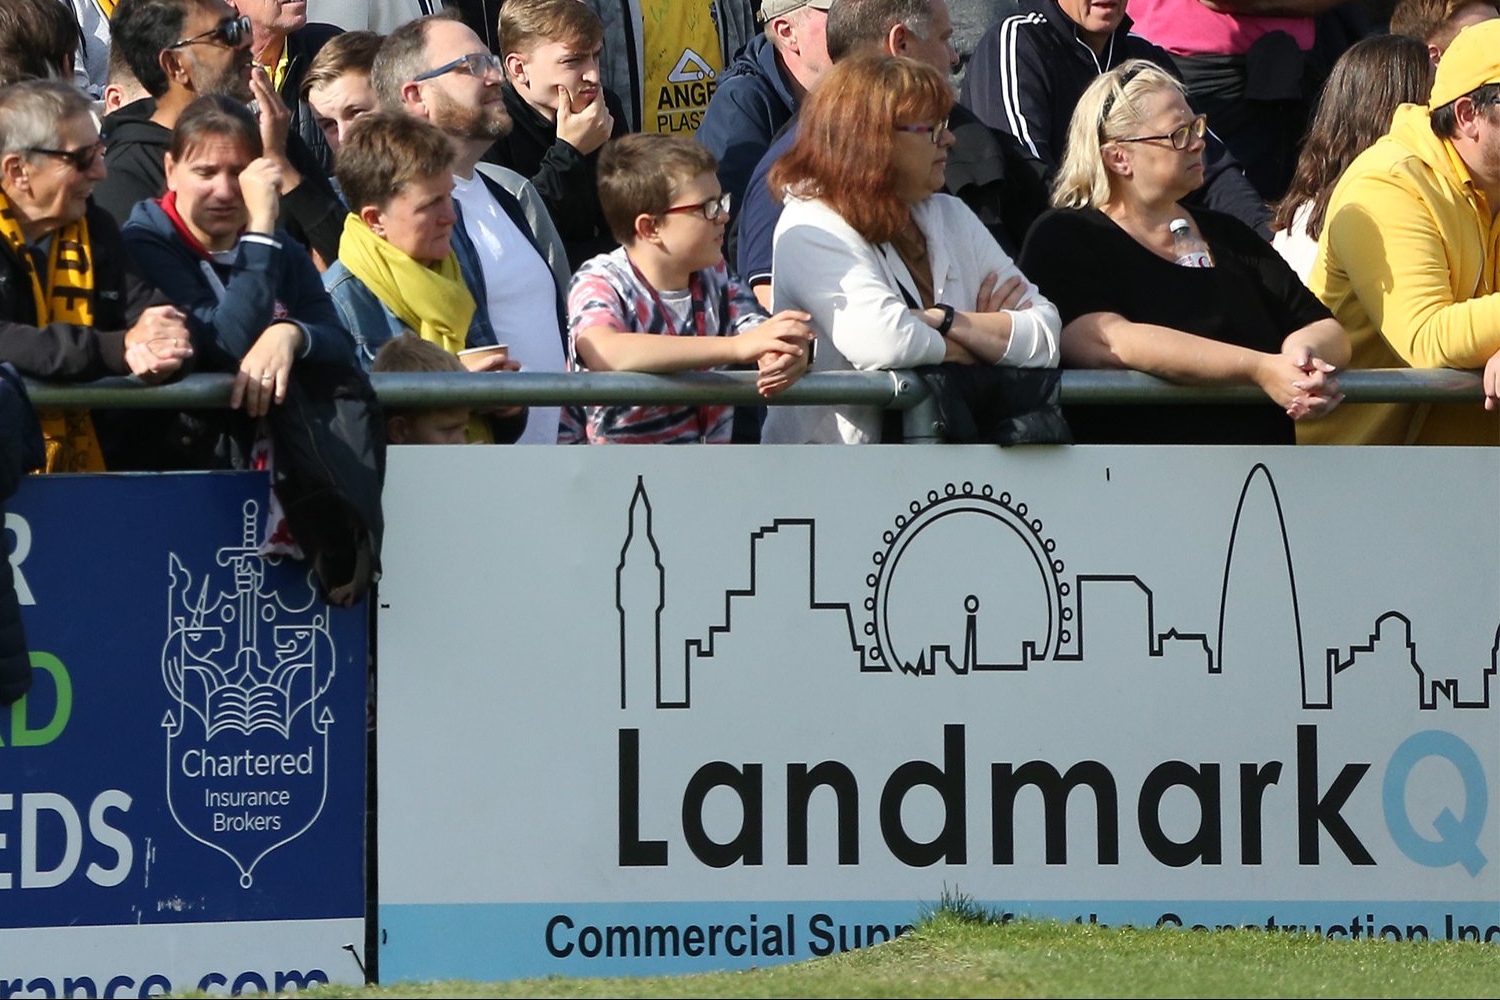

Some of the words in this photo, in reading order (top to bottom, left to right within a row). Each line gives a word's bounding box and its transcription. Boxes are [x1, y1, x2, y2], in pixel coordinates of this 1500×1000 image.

[657, 81, 717, 110] ANGE
[657, 111, 706, 133] PLAS
[181, 746, 313, 778] Chartered
[205, 788, 291, 807] Insurance
[213, 812, 282, 832] Brokers
[545, 913, 796, 959] Commercial
